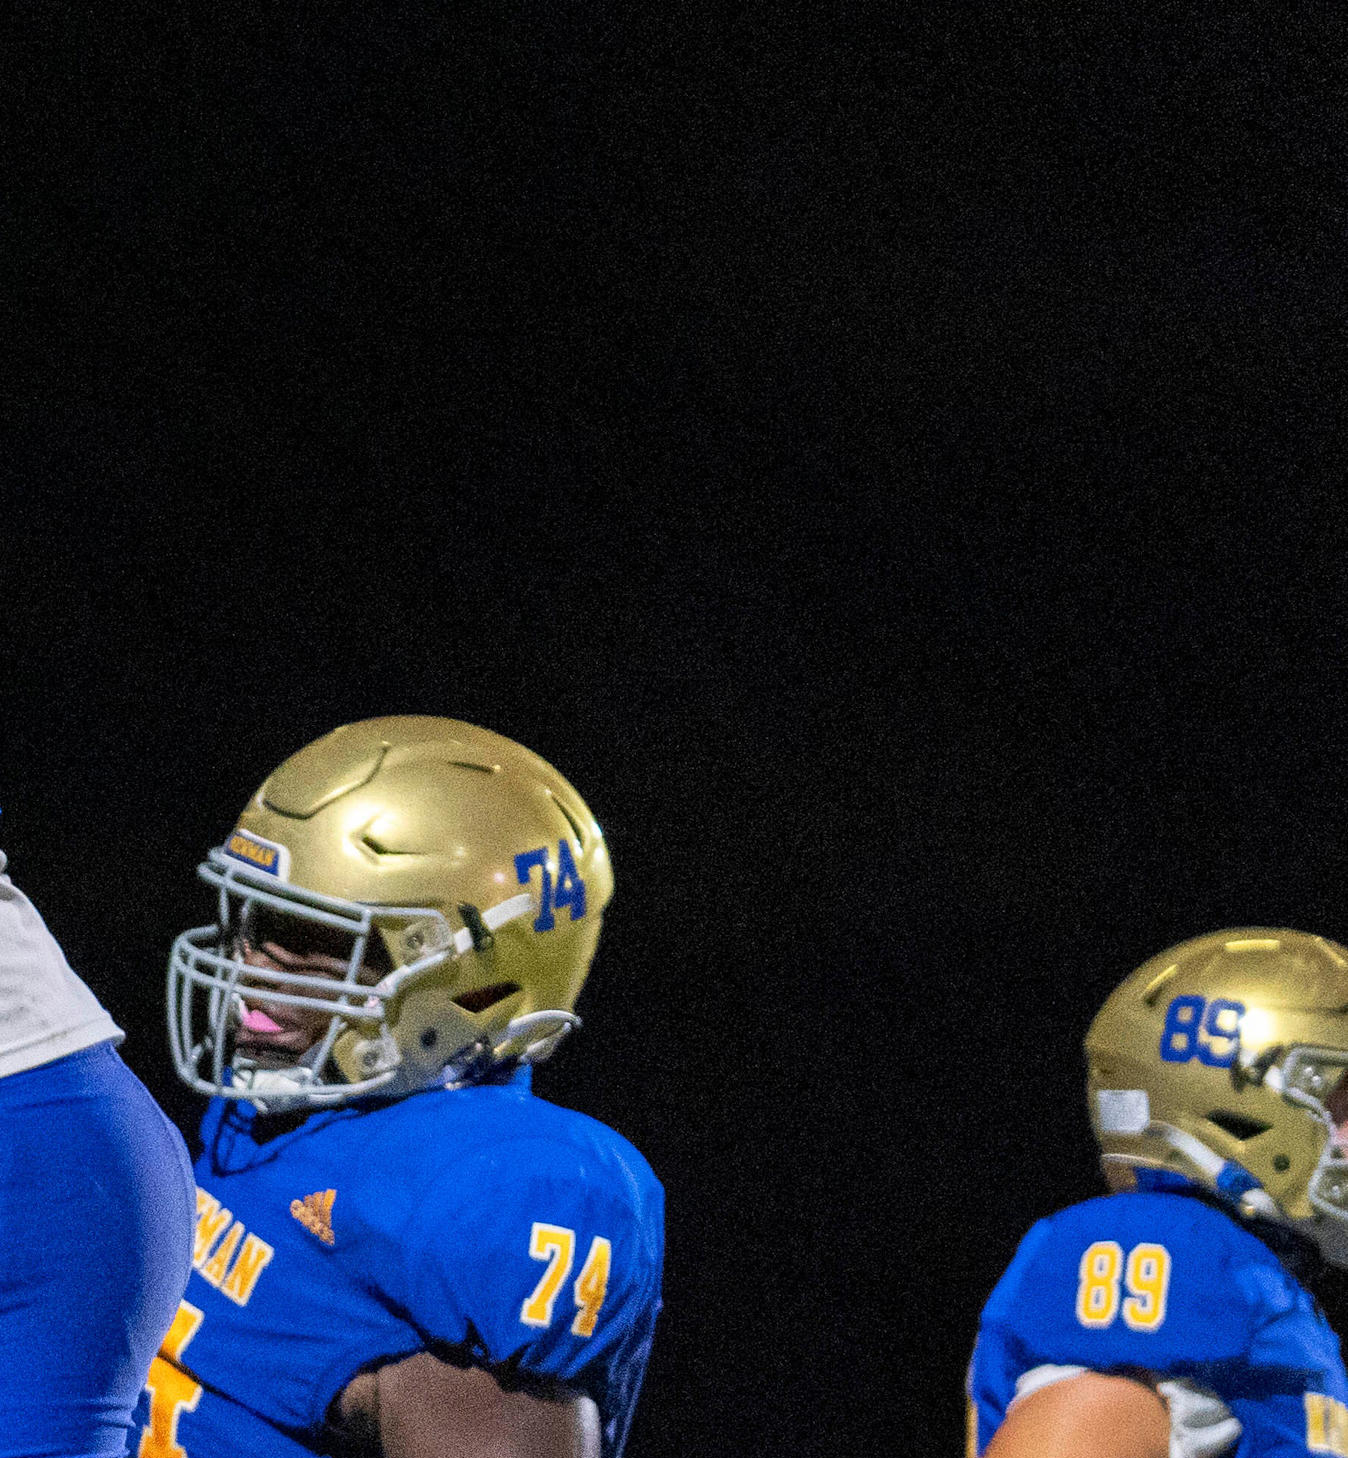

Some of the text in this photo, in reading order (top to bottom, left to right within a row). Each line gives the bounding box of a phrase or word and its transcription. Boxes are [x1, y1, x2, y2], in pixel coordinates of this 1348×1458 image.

[513, 838, 588, 934] 74
[1158, 993, 1246, 1068] 89
[520, 1222, 613, 1338] 74
[1074, 1240, 1172, 1331] 89
